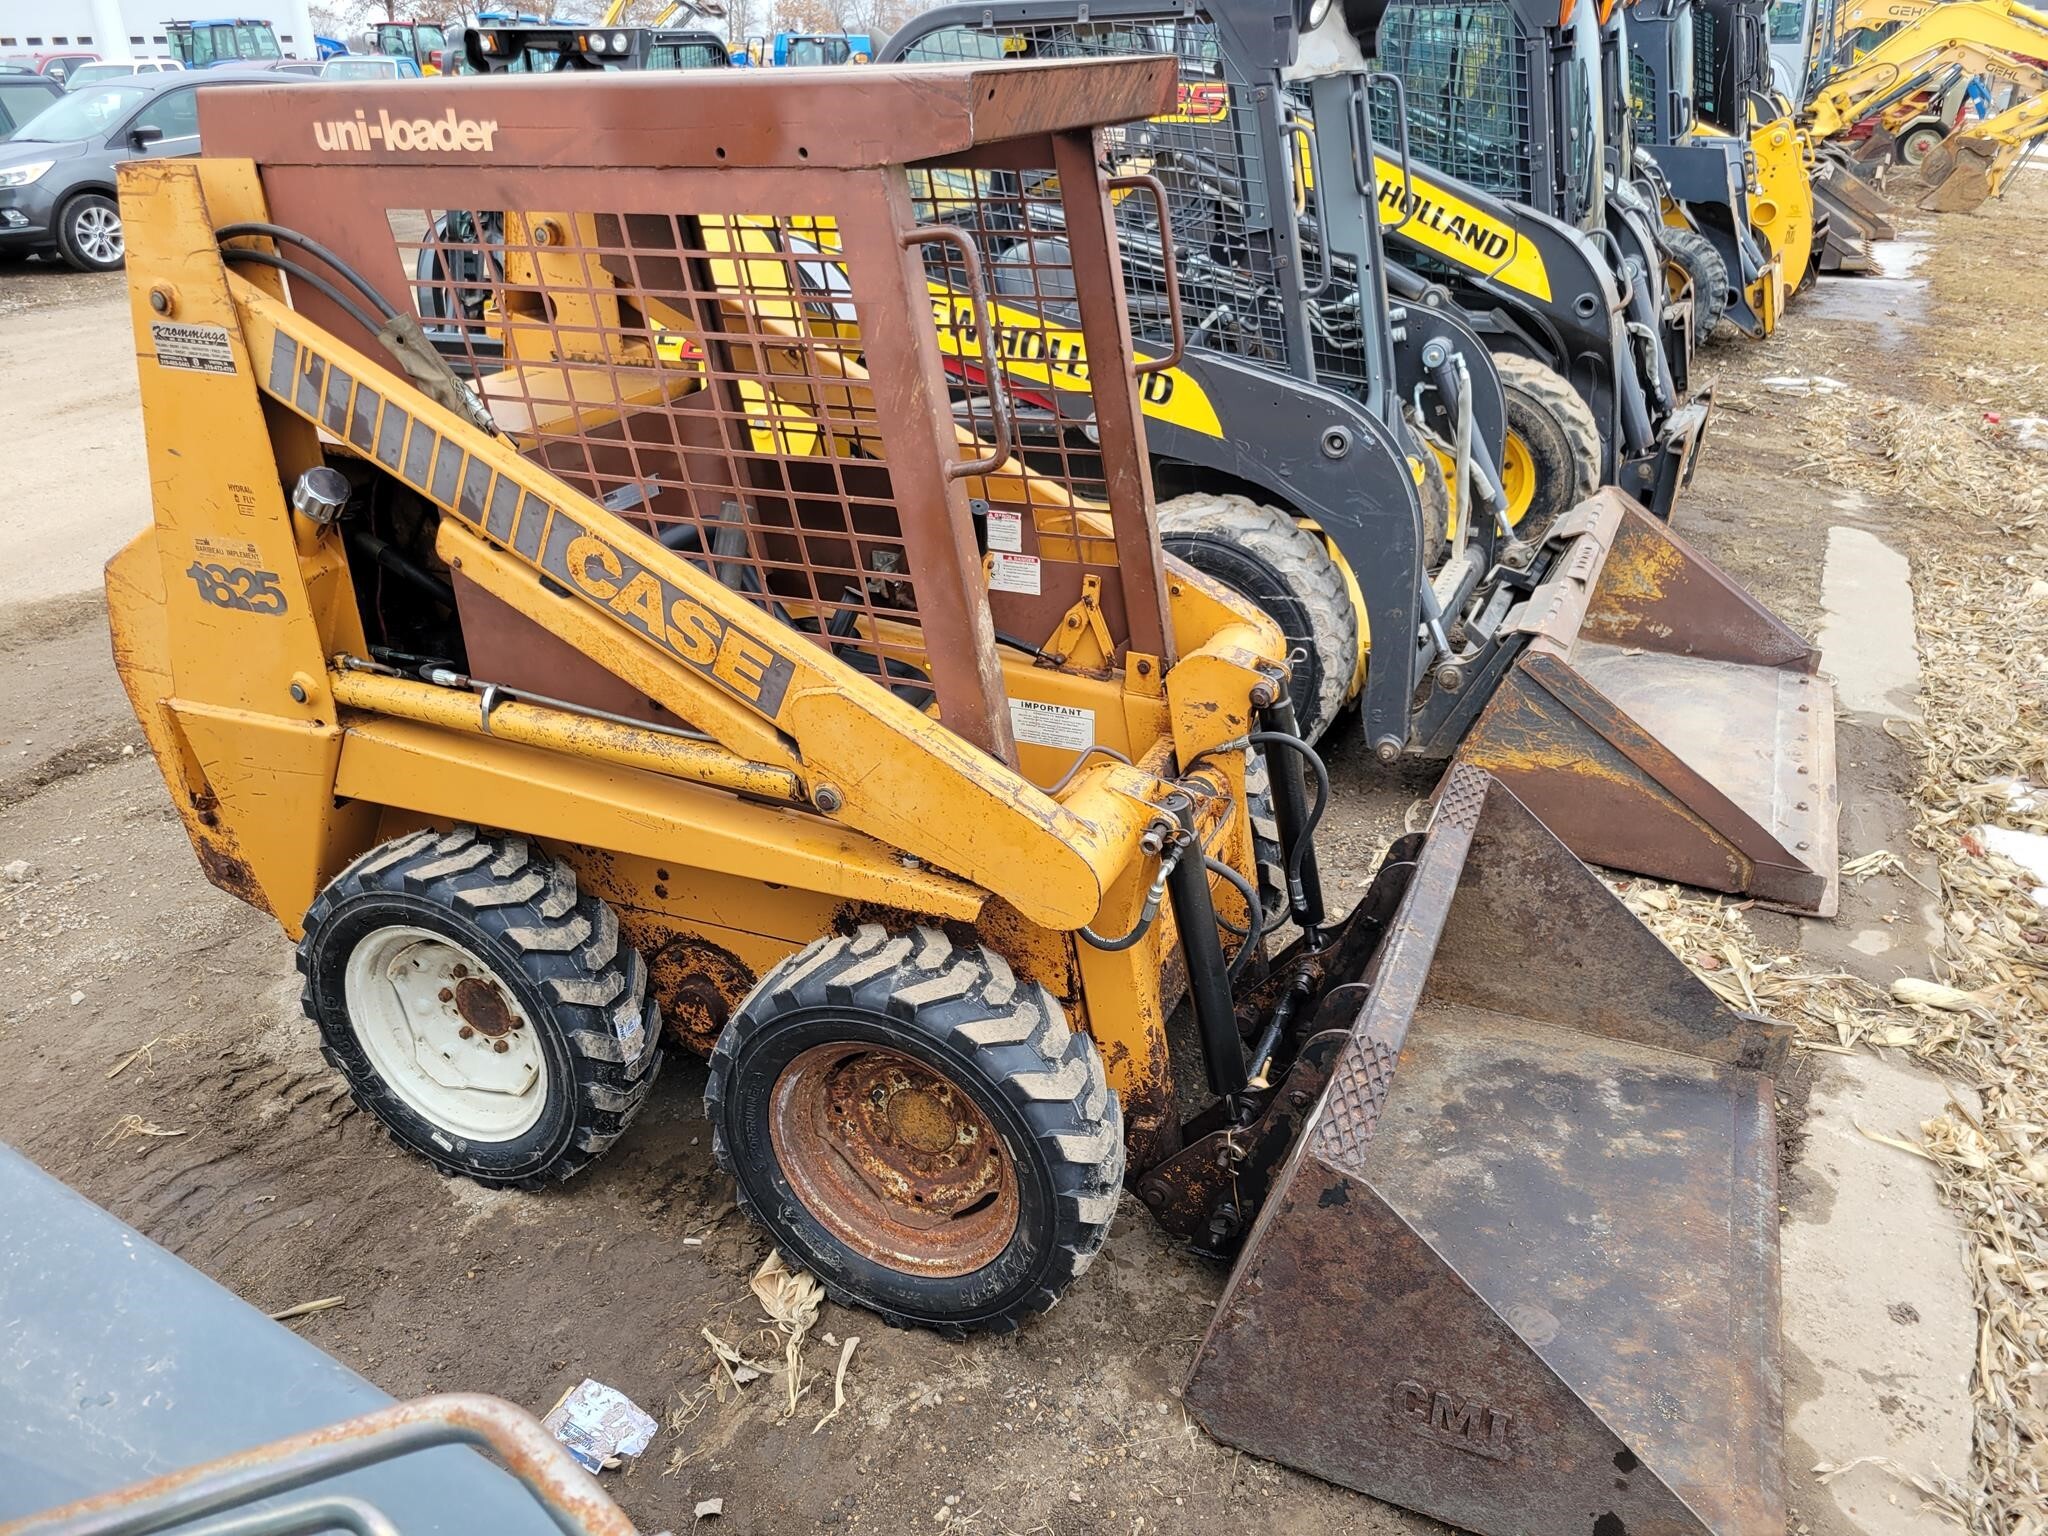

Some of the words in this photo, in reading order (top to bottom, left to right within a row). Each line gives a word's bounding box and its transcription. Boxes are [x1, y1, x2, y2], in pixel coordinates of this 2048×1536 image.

[1888, 4, 1928, 17] GEH
[1984, 62, 2020, 82] GEHL
[313, 108, 498, 152] uni-loader
[1378, 180, 1509, 260] HOLLAND
[152, 325, 228, 344] Kromminga
[992, 321, 1174, 406] HOLLD
[186, 560, 288, 616] 1825
[566, 536, 774, 702] CASE
[1020, 701, 1083, 717] IMPORTANT
